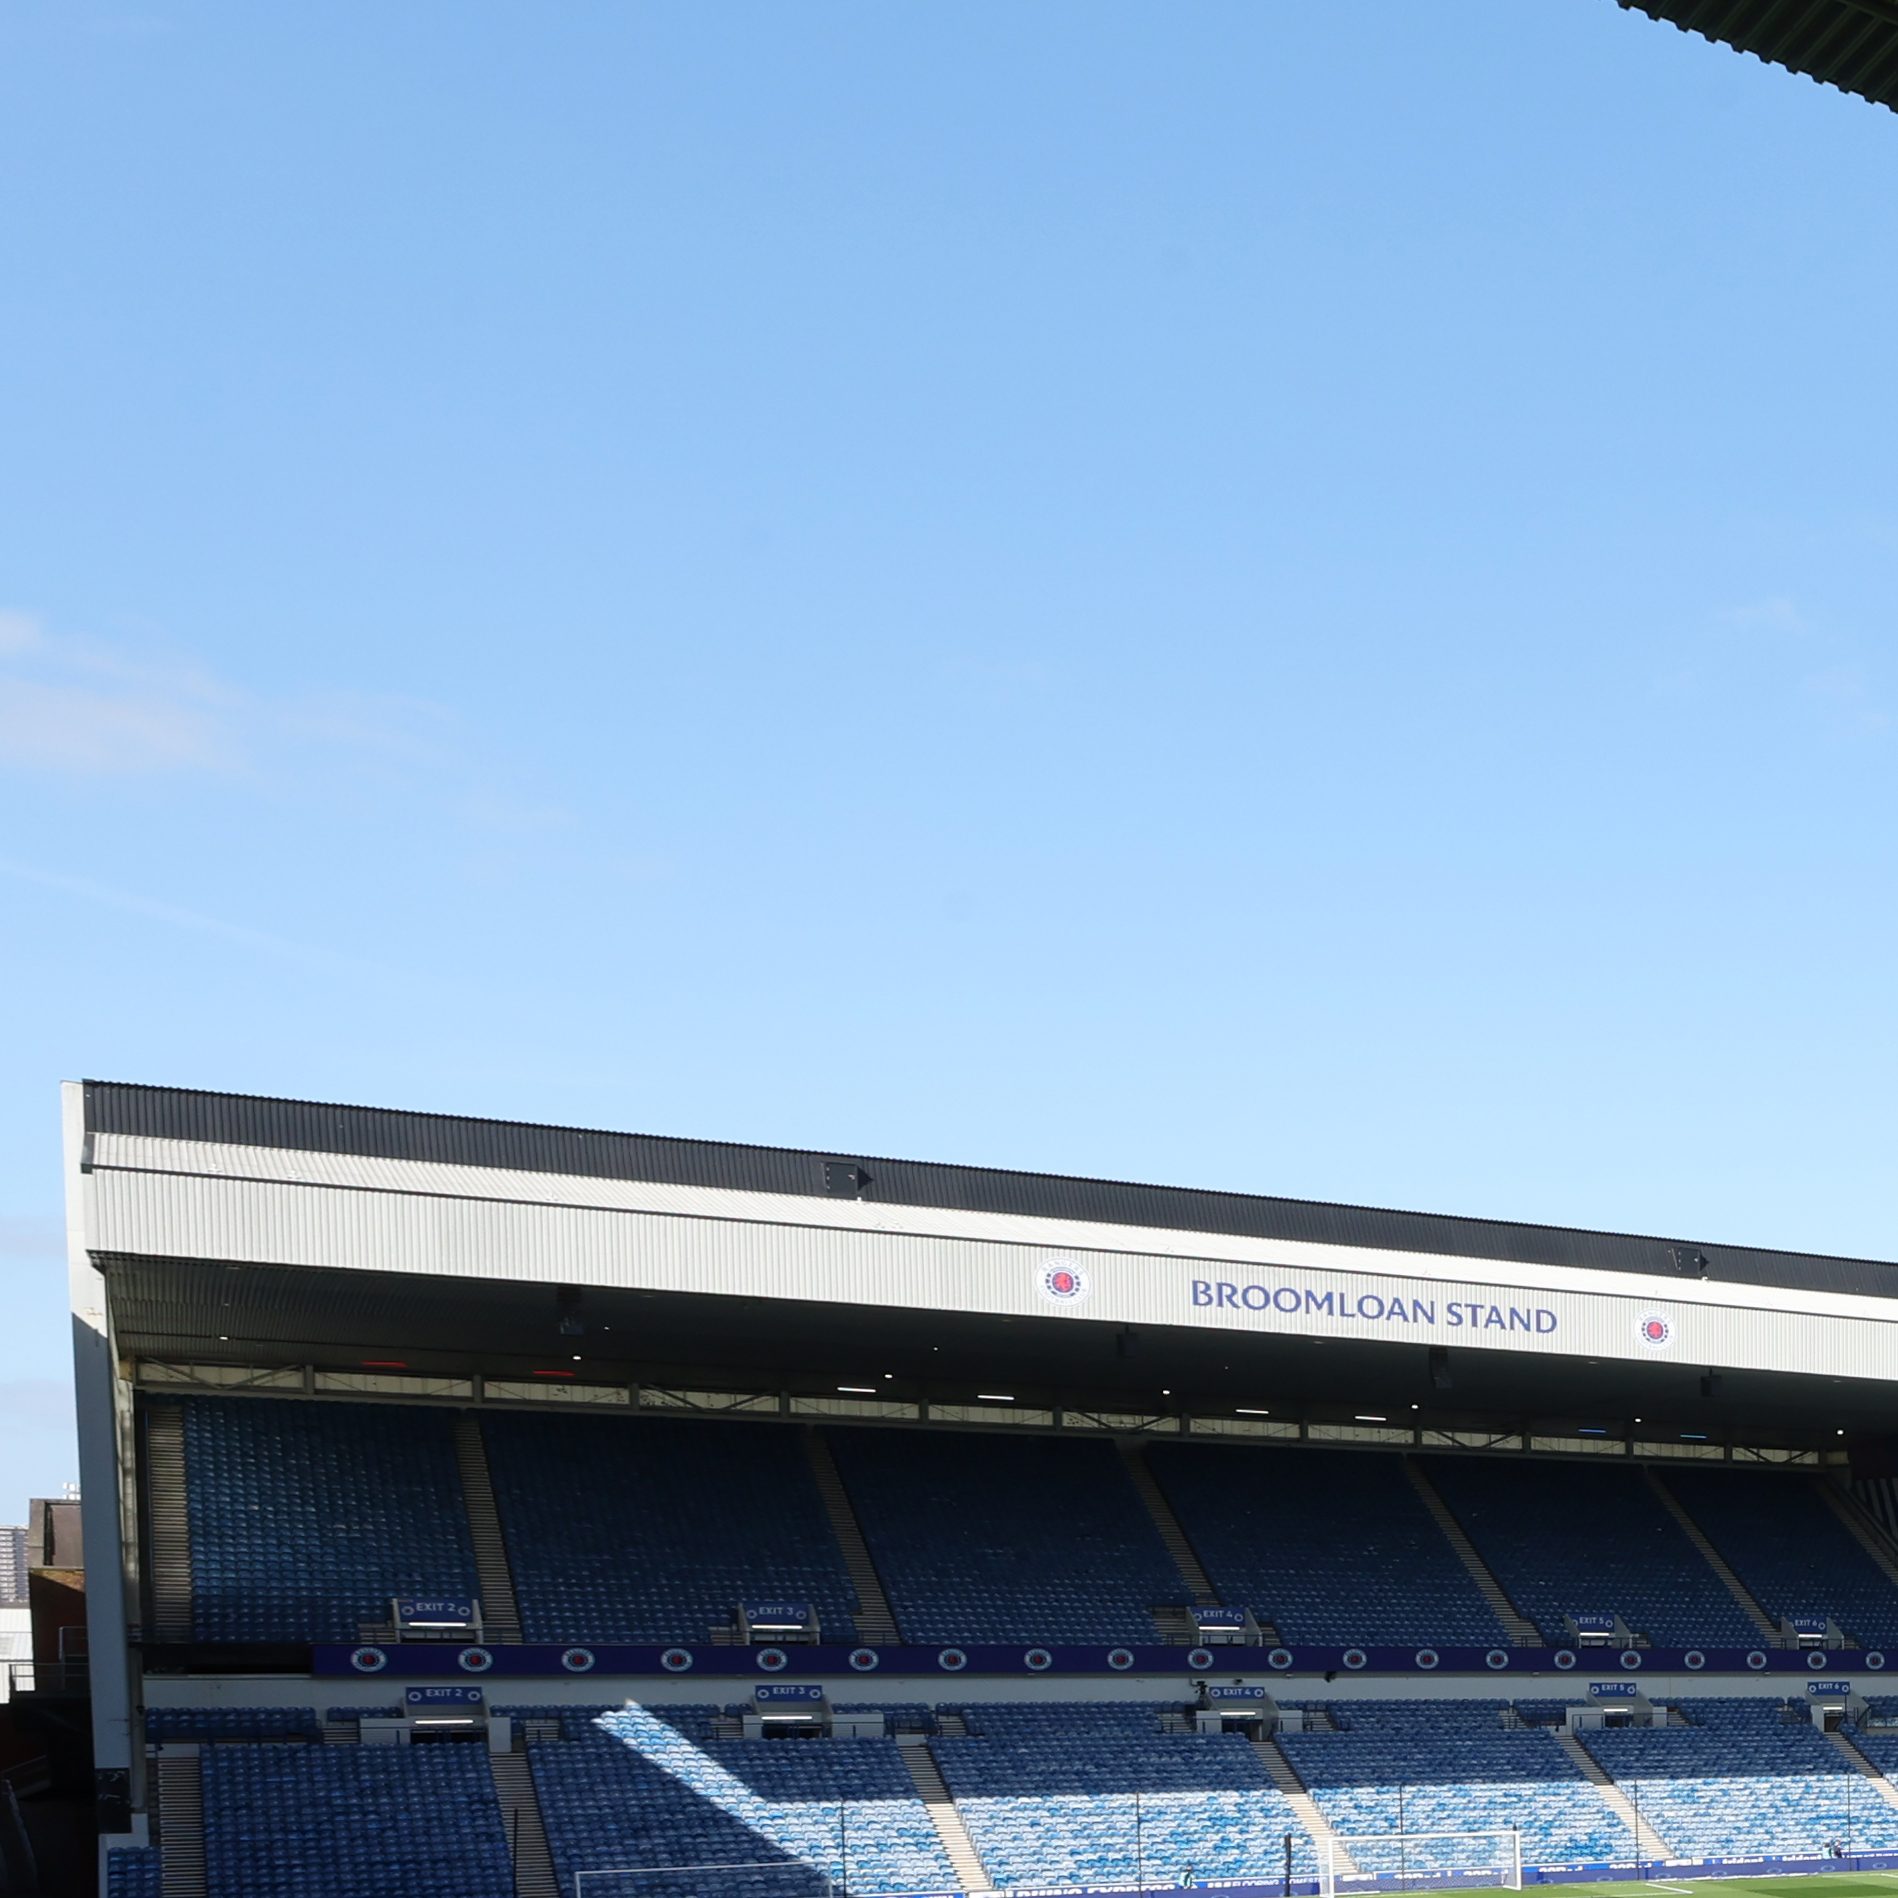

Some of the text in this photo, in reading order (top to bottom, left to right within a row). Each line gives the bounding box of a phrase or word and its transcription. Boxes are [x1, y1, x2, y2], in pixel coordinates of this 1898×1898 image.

[1191, 1279, 1557, 1334] BROOMLOAN STAND
[415, 1603, 456, 1612] EXIT 2
[760, 1606, 793, 1615] EXIT 3
[1202, 1610, 1224, 1618] EXIT
[1578, 1616, 1597, 1624] EXIT
[425, 1689, 463, 1698] EXIT 2
[772, 1686, 806, 1695] EXIT 3
[1223, 1689, 1242, 1697] EXIT
